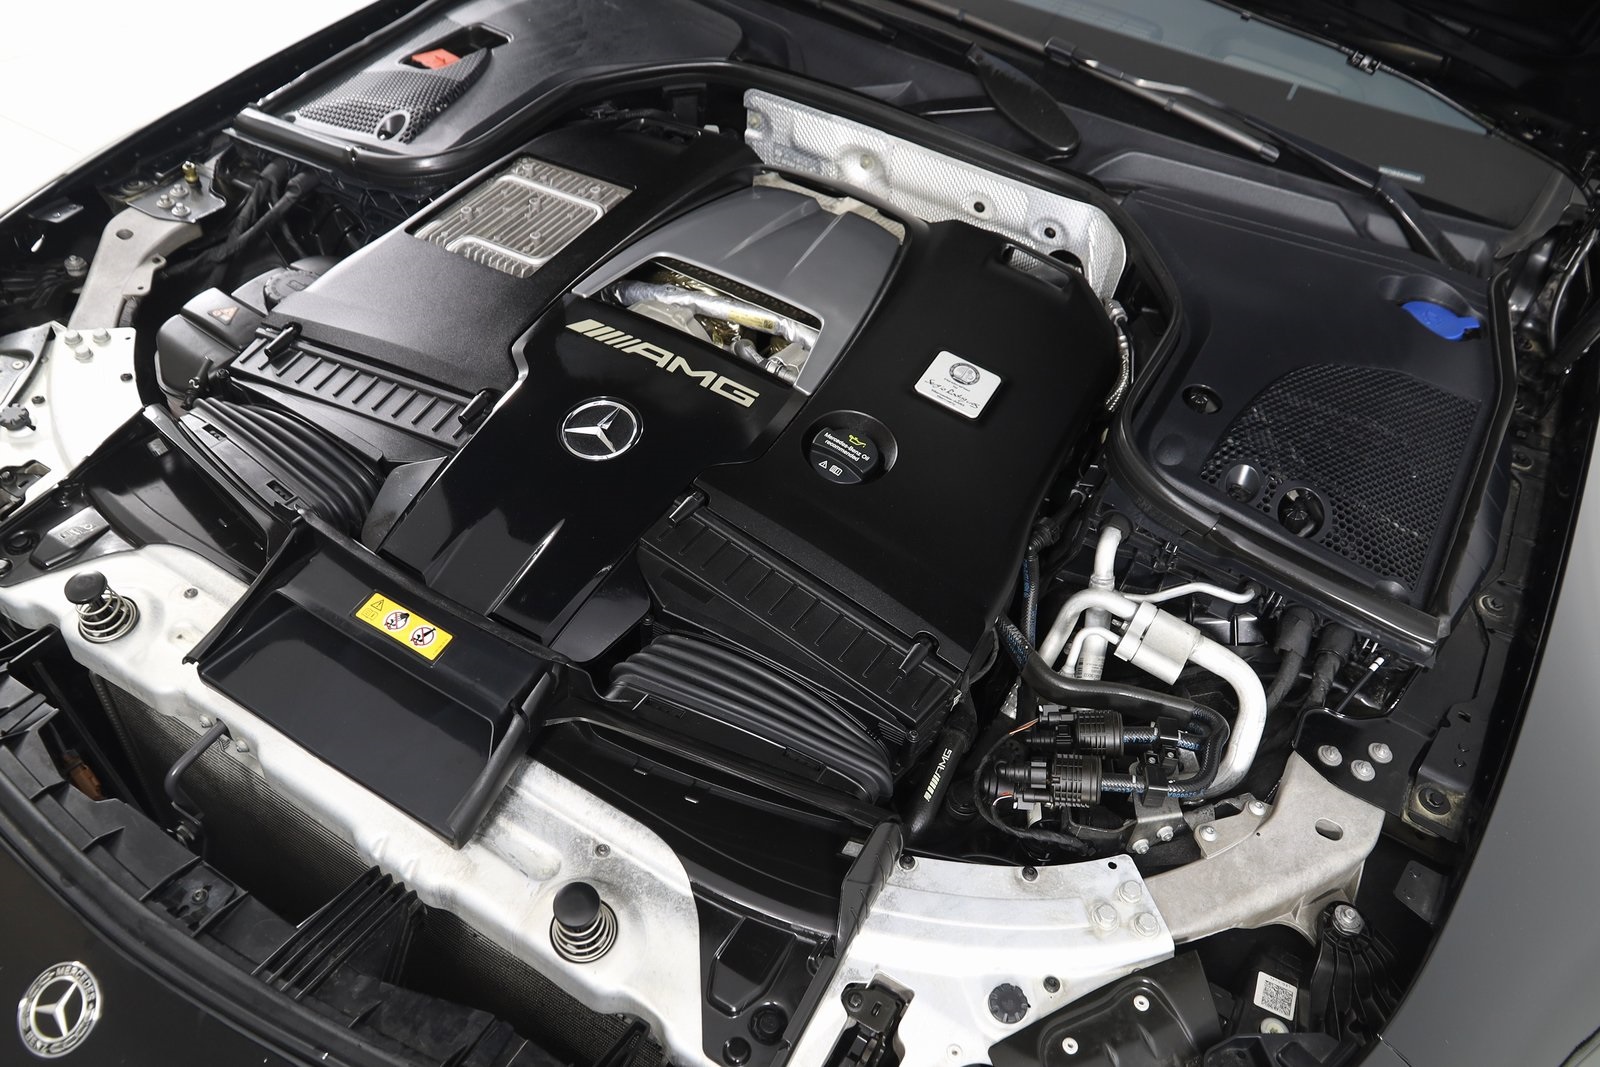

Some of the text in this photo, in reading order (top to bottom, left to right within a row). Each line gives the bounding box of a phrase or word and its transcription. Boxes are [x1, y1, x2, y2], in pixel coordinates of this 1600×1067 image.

[621, 341, 760, 408] AMG
[823, 432, 871, 462] Mercedes-Benz Oil
[824, 439, 860, 462] recommended
[55, 964, 97, 1002] MERCEDES
